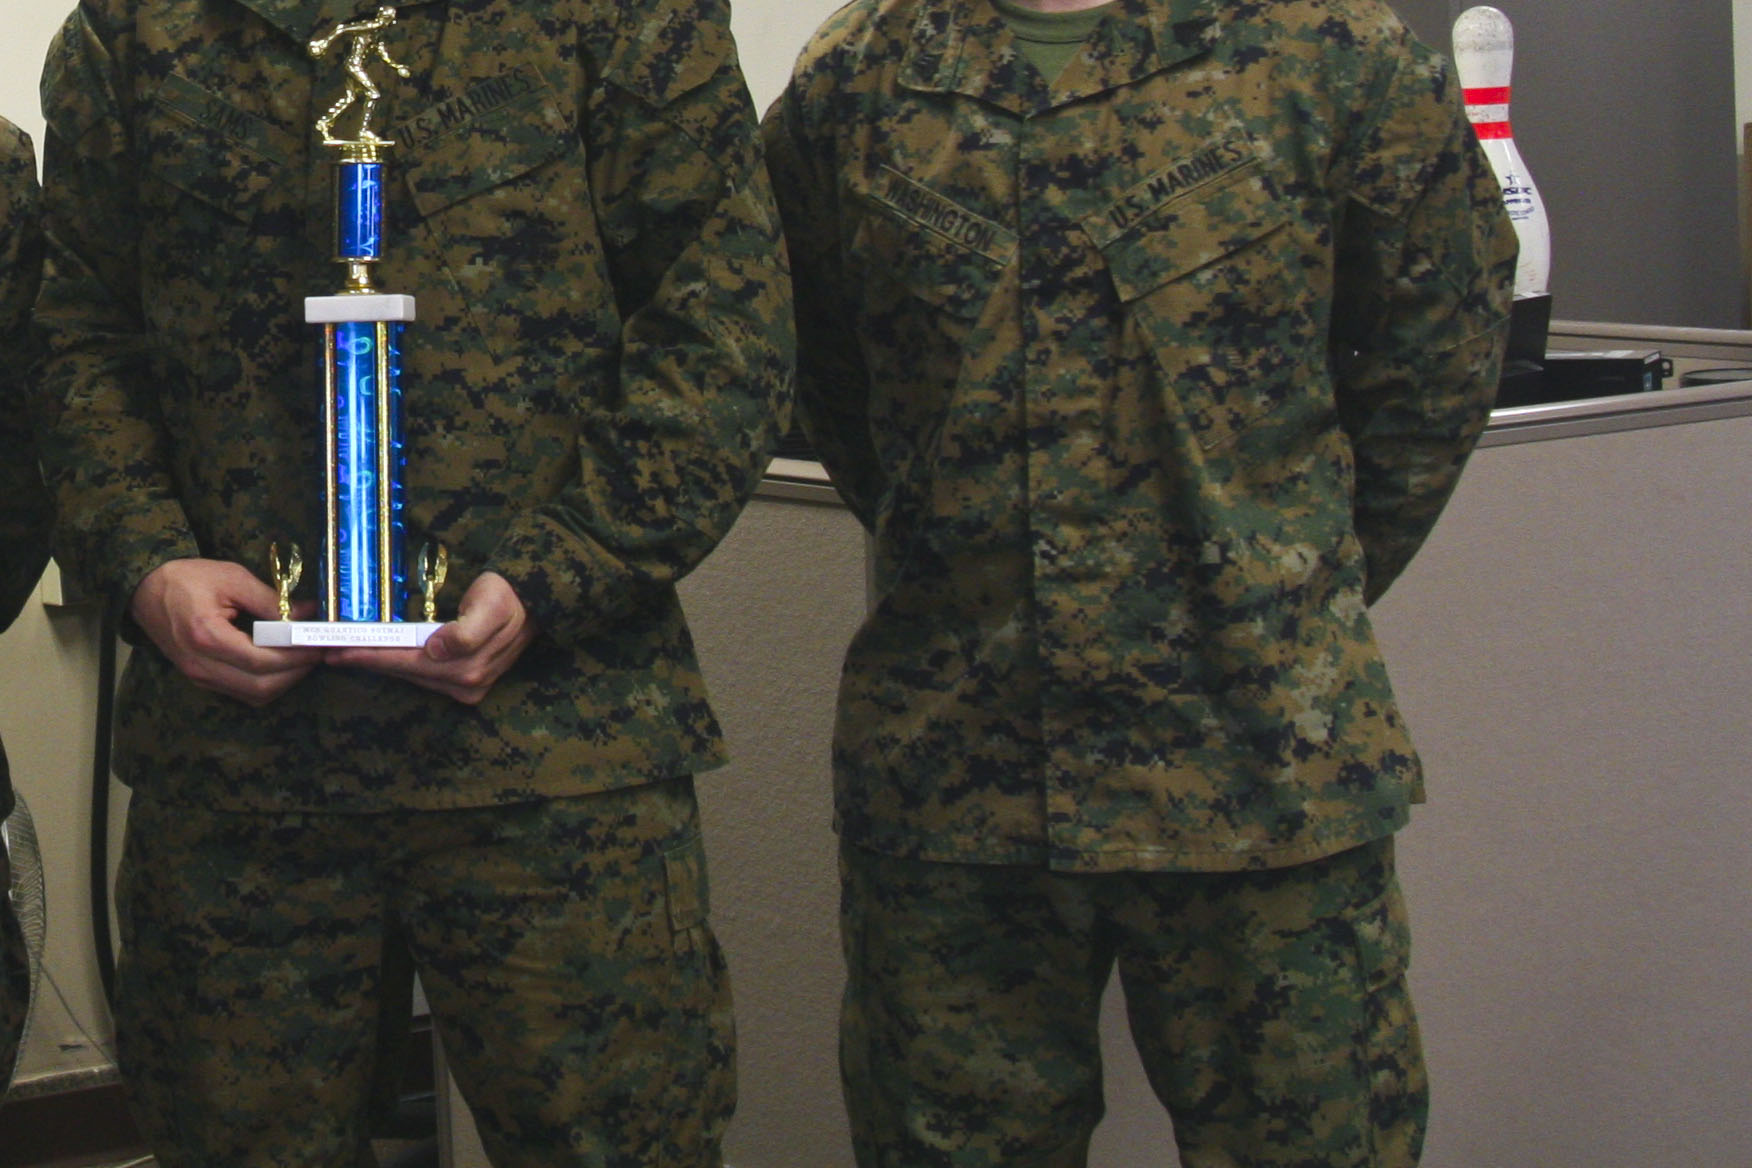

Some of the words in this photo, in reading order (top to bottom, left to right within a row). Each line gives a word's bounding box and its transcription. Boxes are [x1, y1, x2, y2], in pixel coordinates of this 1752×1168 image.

[437, 68, 532, 129] MARINES
[1147, 140, 1243, 202] MARINES
[885, 177, 997, 252] WASHINGTON
